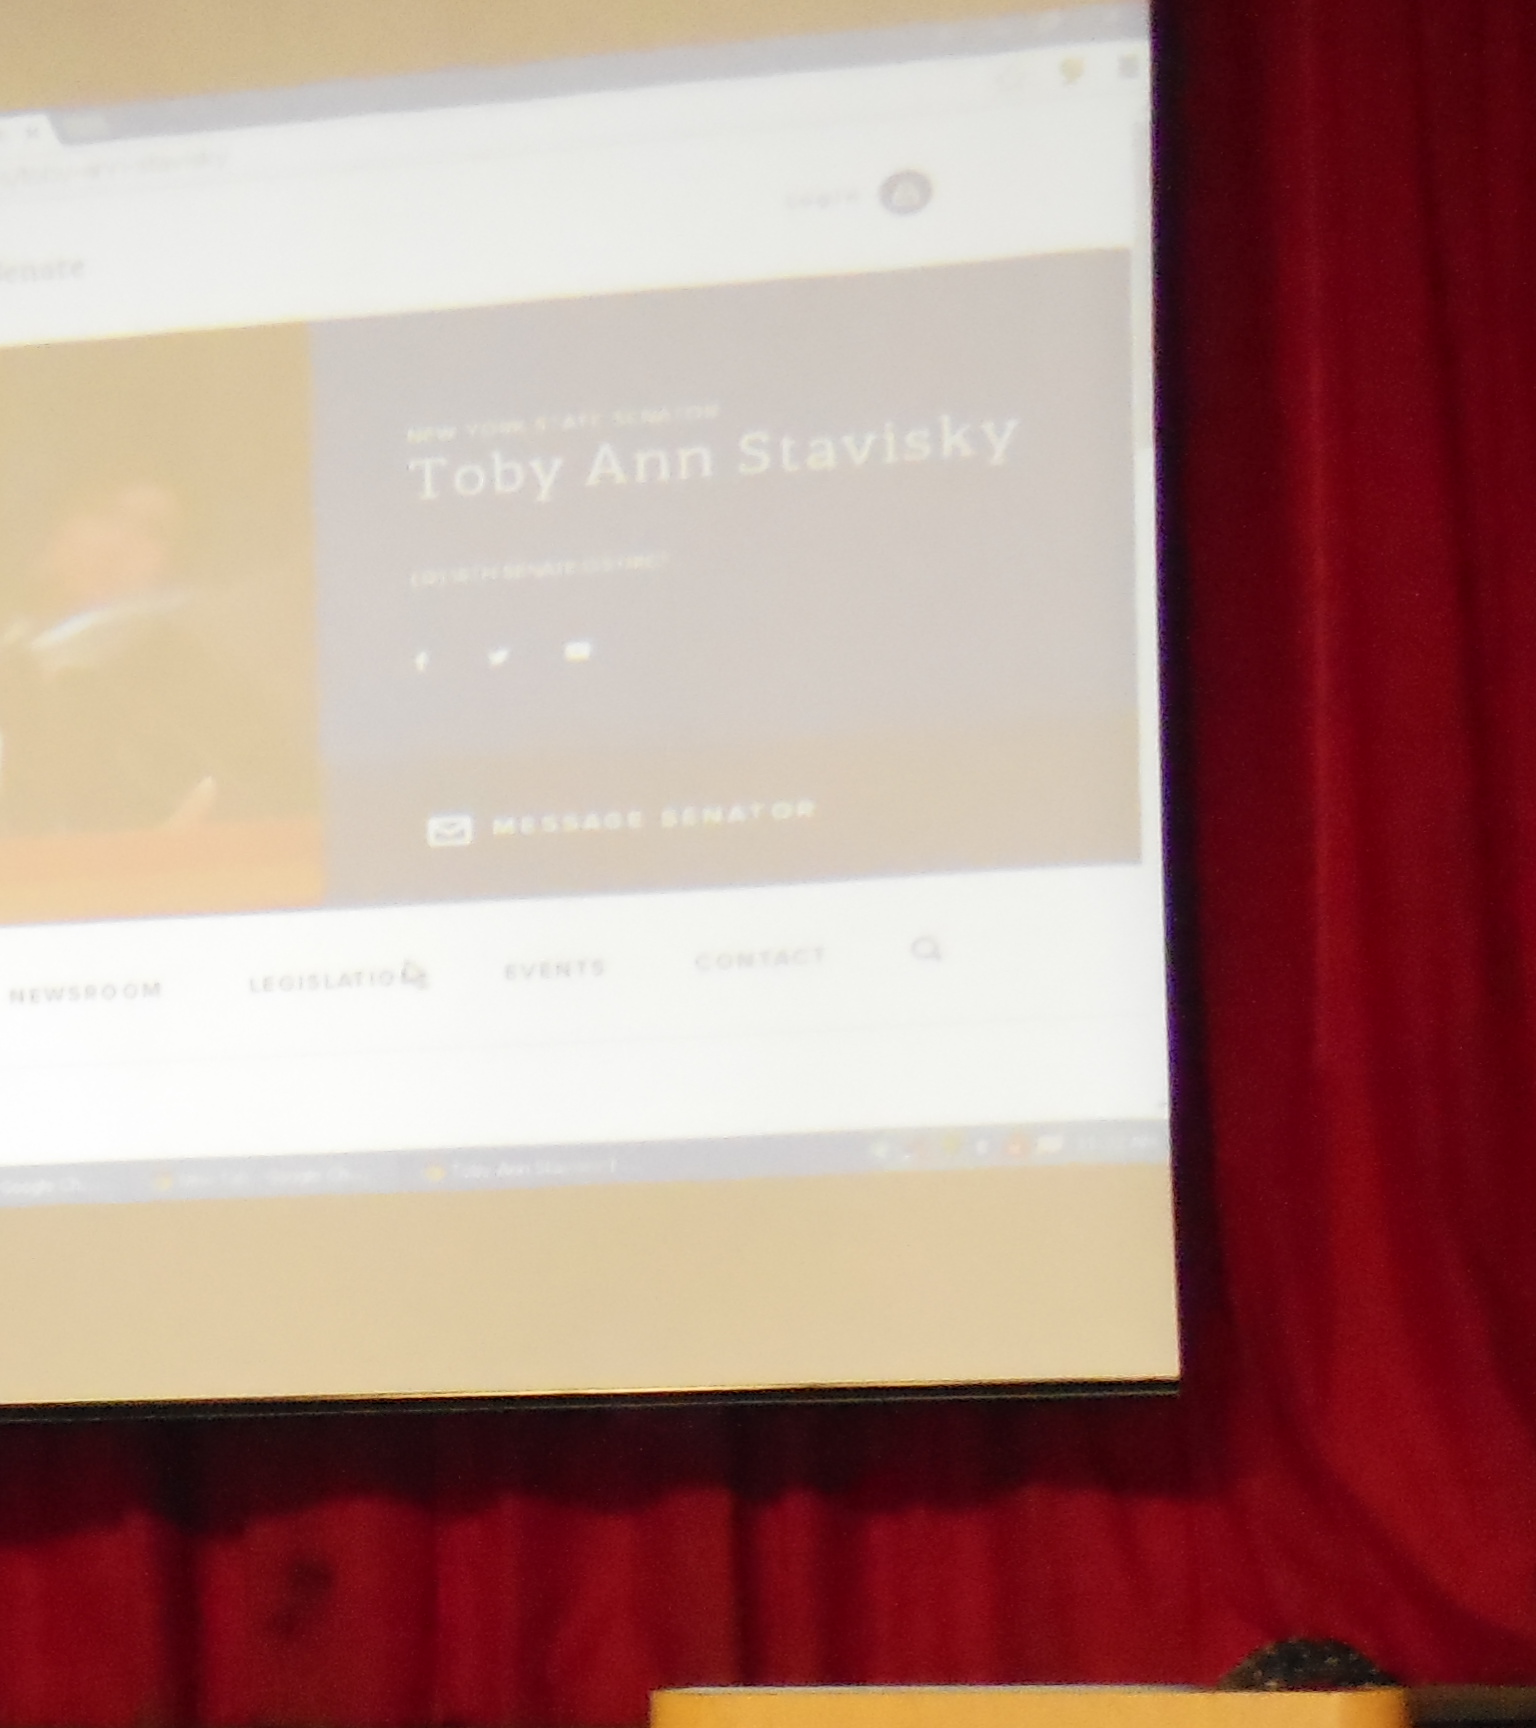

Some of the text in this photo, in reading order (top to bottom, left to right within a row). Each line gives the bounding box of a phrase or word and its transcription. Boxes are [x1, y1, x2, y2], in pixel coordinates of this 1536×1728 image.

[406, 413, 1021, 504] Toby Ann Stavisky
[490, 796, 817, 837] MESSAGE SENATOR
[7, 979, 163, 1004] NEWSROOM
[502, 957, 608, 981] EVENTS
[692, 944, 825, 972] CONTACT
